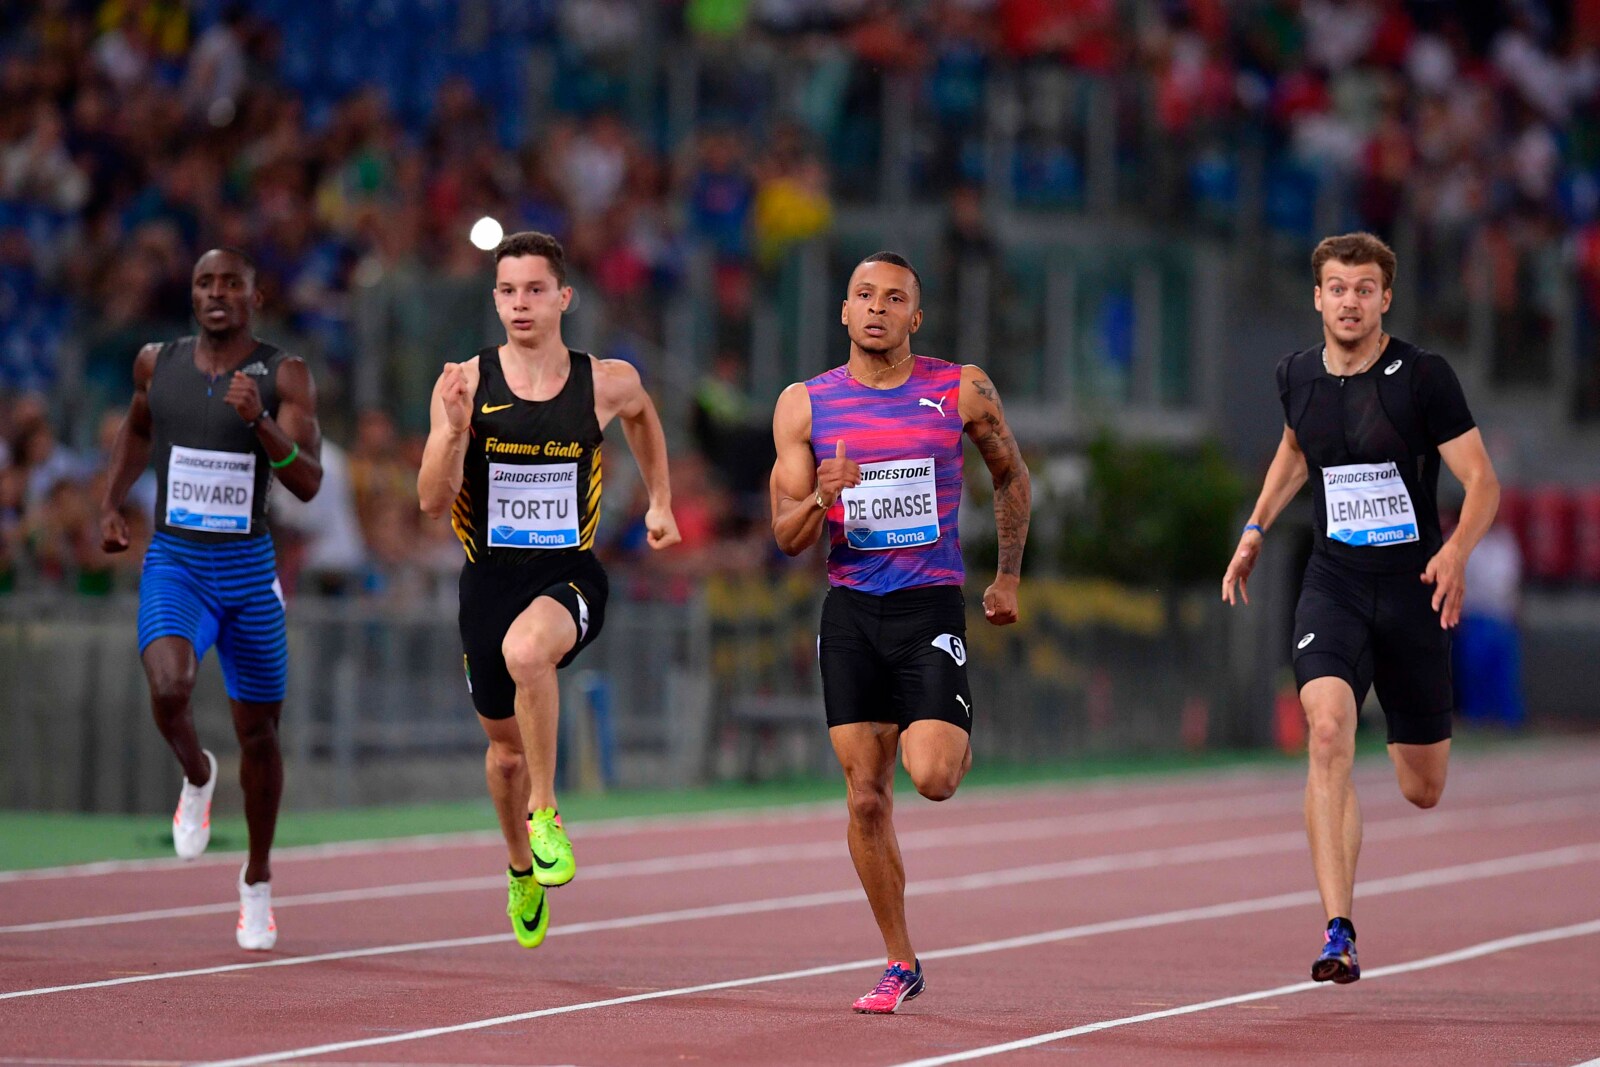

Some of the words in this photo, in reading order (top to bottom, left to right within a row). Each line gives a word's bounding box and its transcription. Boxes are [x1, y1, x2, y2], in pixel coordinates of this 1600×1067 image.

[485, 437, 540, 456] Fiamme
[544, 440, 583, 458] Gialle
[175, 453, 251, 472] BRIDGESTONE
[493, 470, 574, 483] BRIDGESTONE
[860, 466, 931, 481] IDGESTONE
[1325, 469, 1401, 485] BRIDGESTON
[172, 481, 247, 505] EDWARD
[497, 499, 568, 520] TORTU
[847, 499, 867, 520] DE
[872, 493, 932, 520] GRASSE
[1331, 494, 1409, 523] LEMAITRE
[528, 532, 565, 544] Roma
[887, 531, 925, 544] Roma
[1367, 529, 1404, 543] Roma
[949, 636, 963, 661] 6
